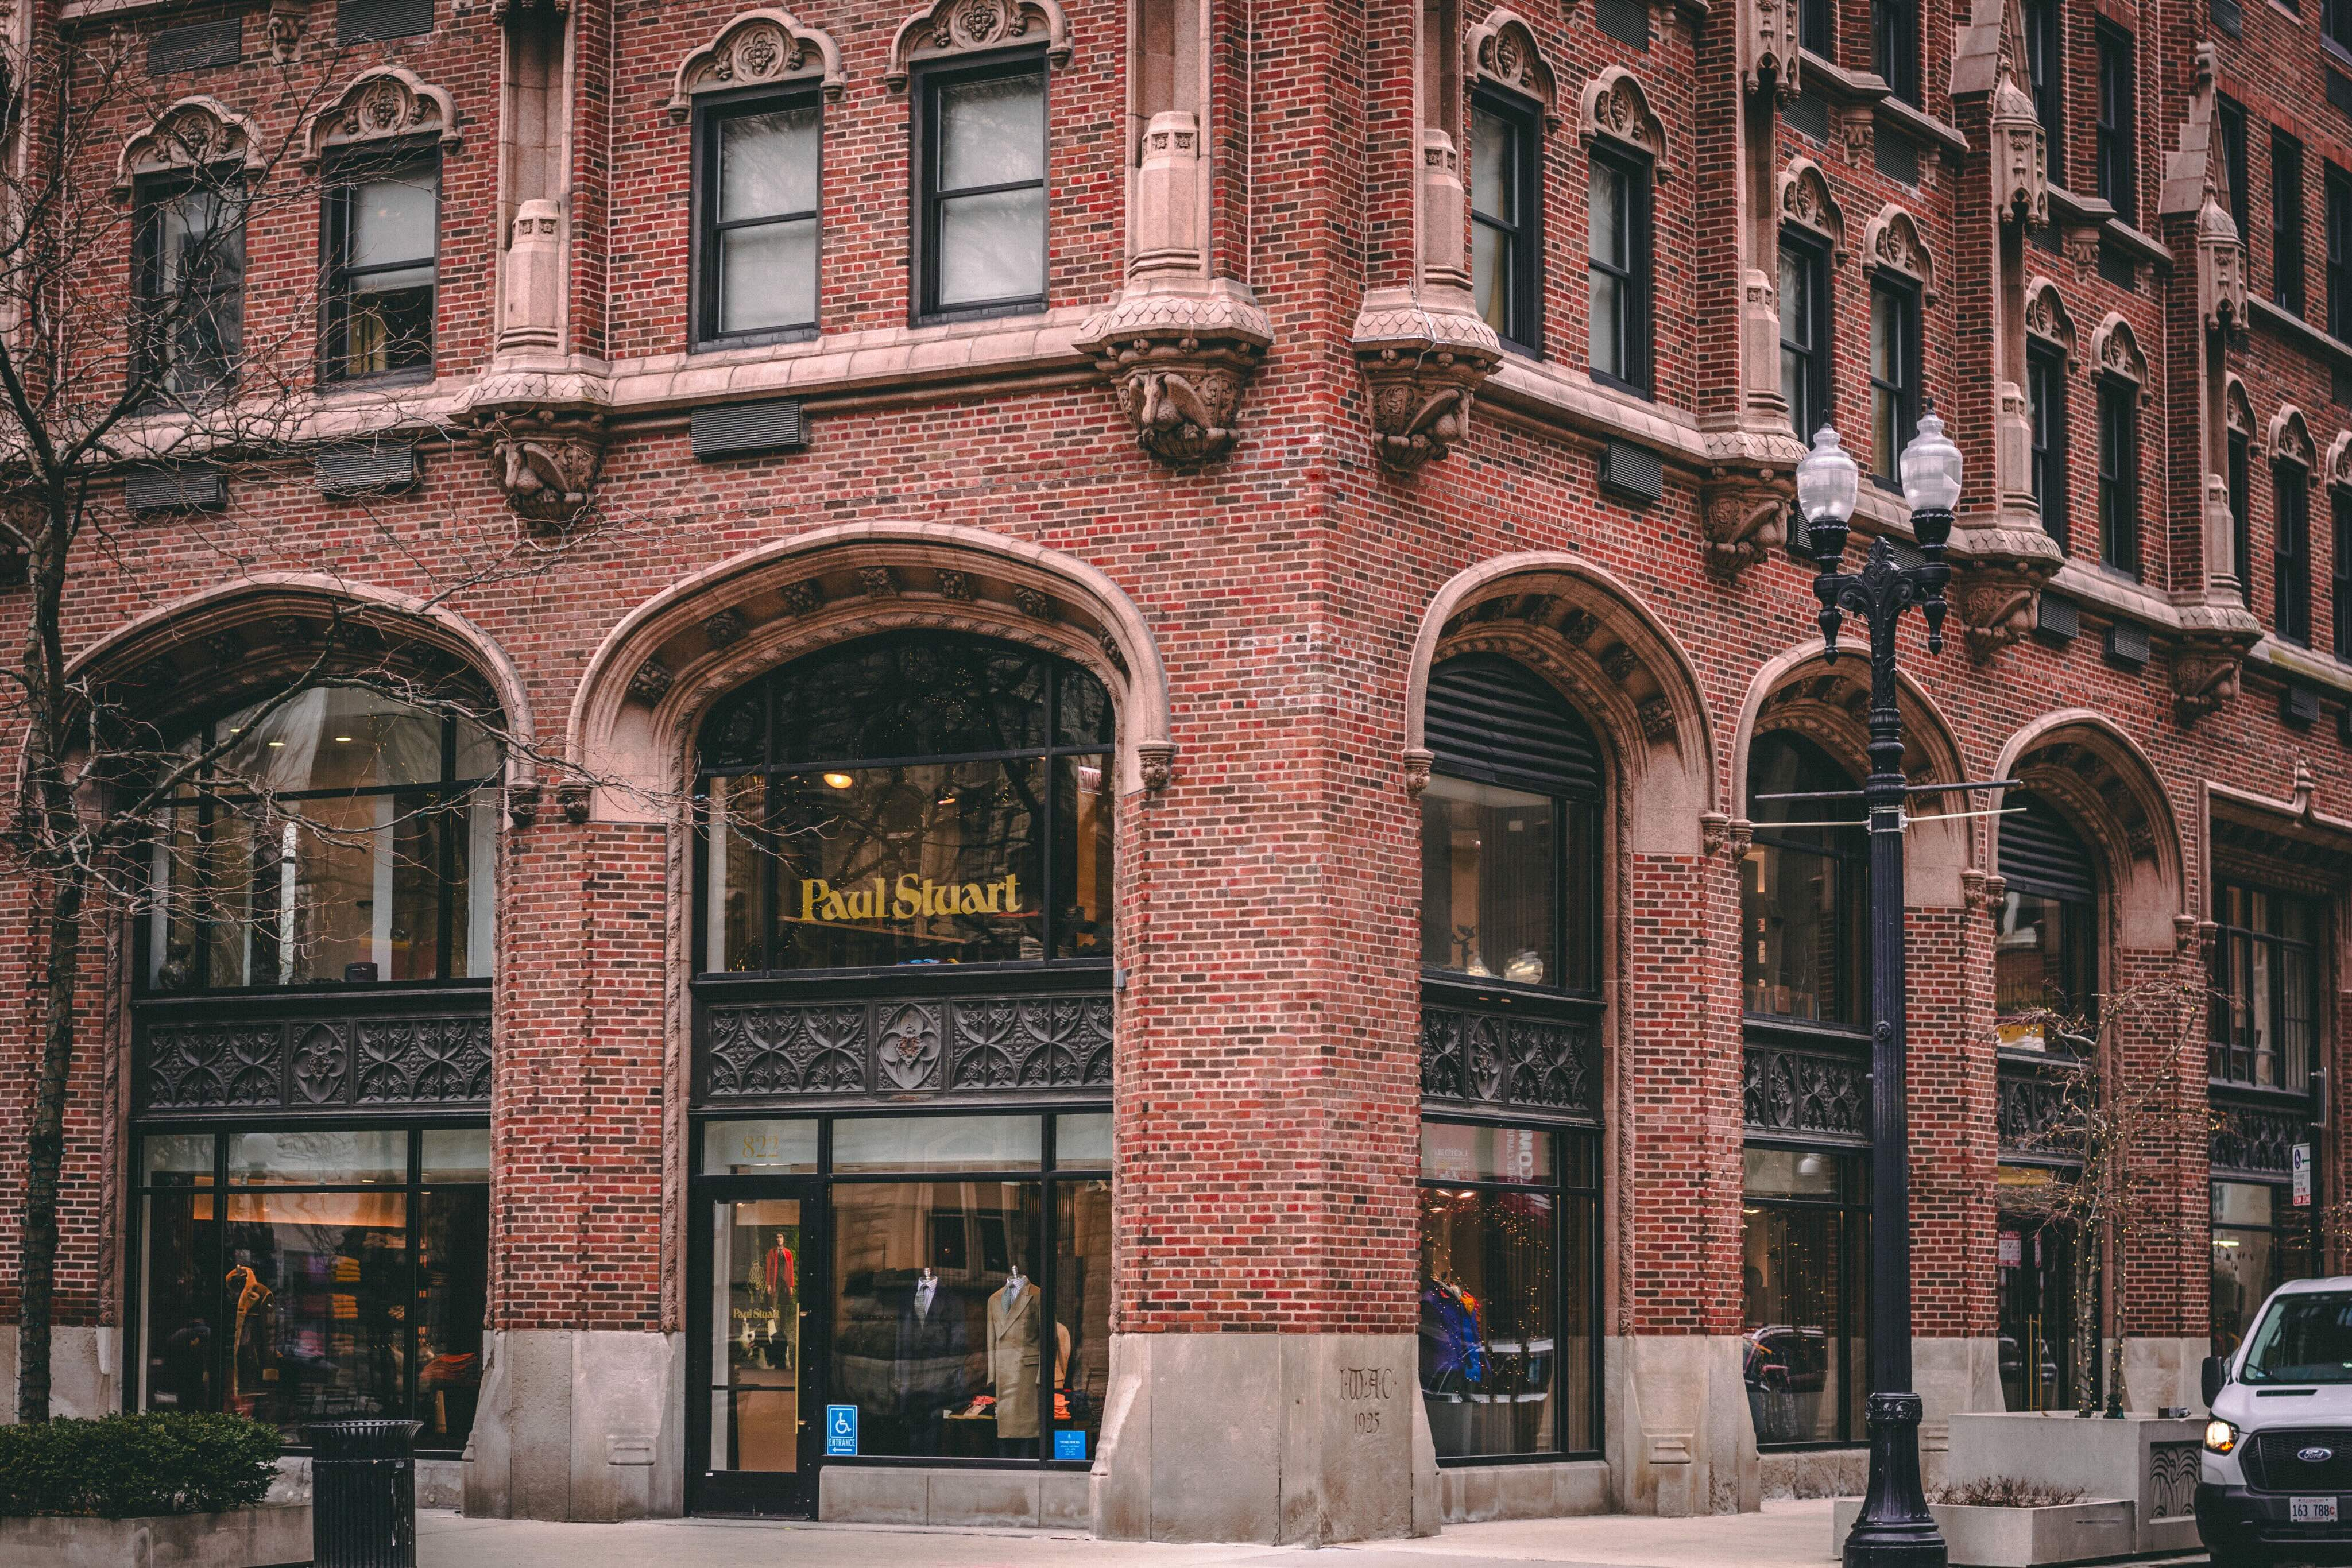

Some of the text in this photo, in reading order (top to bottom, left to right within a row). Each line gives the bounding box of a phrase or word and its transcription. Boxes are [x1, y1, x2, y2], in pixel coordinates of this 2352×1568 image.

[800, 873, 1022, 922] Paul Stuart
[742, 1135, 780, 1157] 822
[733, 1308, 752, 1318] Paul
[1355, 1412, 1380, 1434] 1925
[829, 1438, 855, 1446] ENTRANCE
[2304, 1450, 2324, 1458] Ford
[2292, 1504, 2308, 1516] 163
